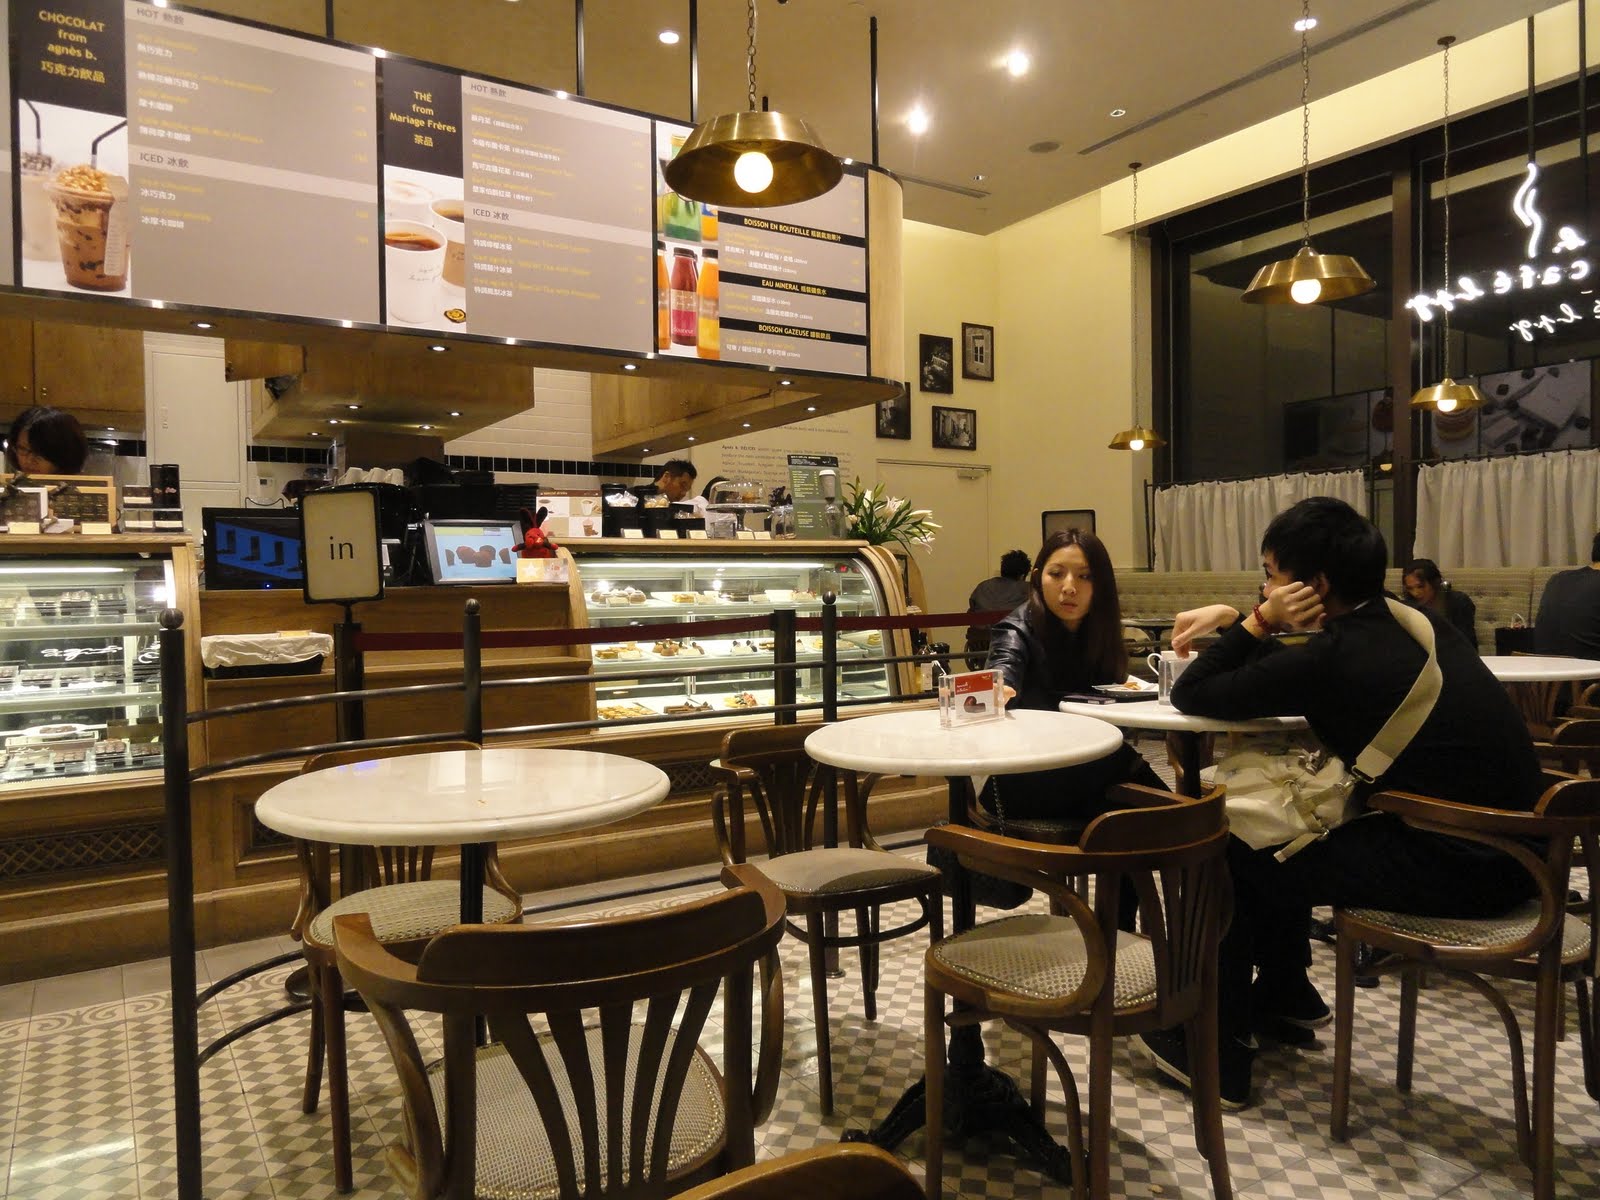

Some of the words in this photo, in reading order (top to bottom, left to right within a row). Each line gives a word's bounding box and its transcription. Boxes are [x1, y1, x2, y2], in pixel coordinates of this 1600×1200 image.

[39, 10, 105, 32] CHOCOLAT
[136, 8, 159, 19] HOT
[58, 29, 87, 43] from
[47, 43, 82, 57] agnès
[85, 48, 98, 60] b.
[41, 60, 106, 83] 巧克力飲品
[471, 83, 488, 92] HOT
[412, 103, 434, 116] from
[389, 112, 425, 128] Mariage
[427, 119, 457, 133] Frères
[140, 152, 164, 164] ICED
[167, 157, 190, 169] 冰飲
[473, 208, 491, 218] ICED
[493, 211, 510, 222] 冰飲
[743, 218, 769, 229] BOISSON
[770, 222, 778, 231] EN
[779, 225, 810, 237] BOUTEILLE
[762, 280, 774, 288] EAU
[775, 281, 799, 292] MINERAL
[758, 324, 783, 334] BOISSON
[784, 328, 809, 337] GAZEUSE
[329, 536, 354, 560] in
